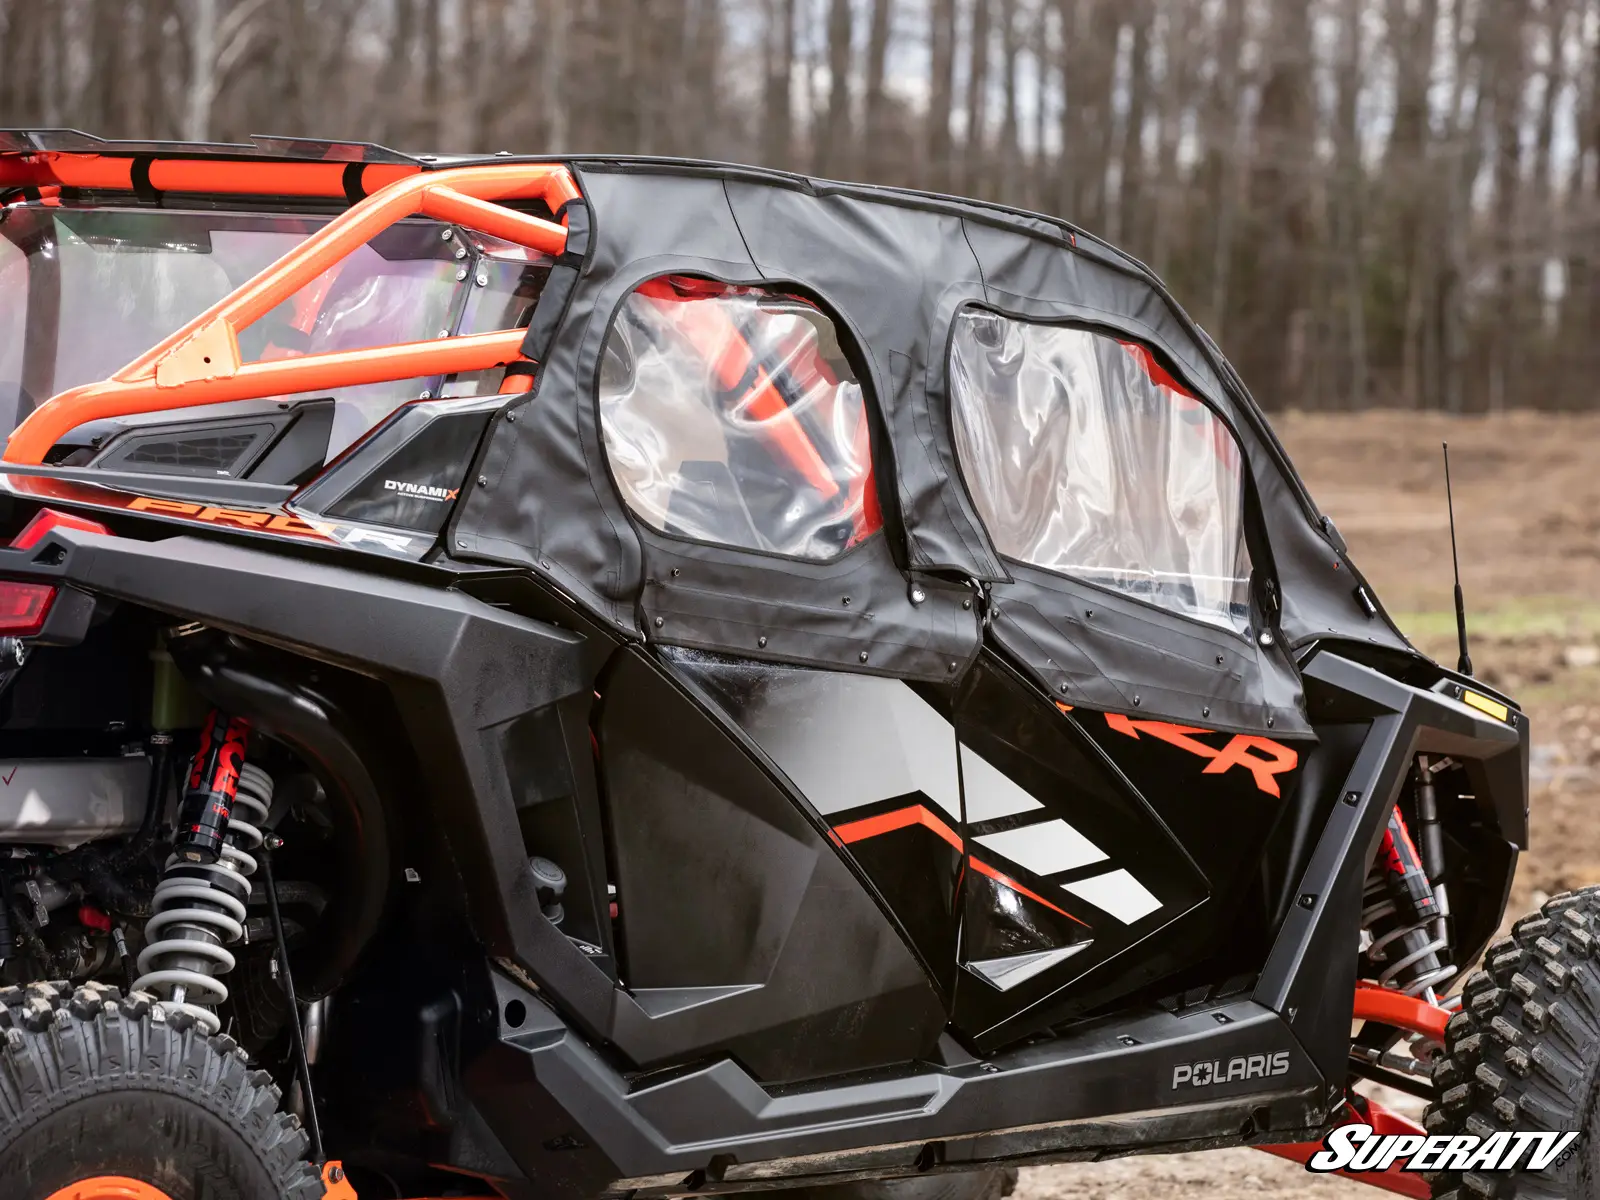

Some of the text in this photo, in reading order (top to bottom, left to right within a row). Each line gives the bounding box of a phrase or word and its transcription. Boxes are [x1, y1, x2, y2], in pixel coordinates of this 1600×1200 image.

[384, 479, 460, 501] DYNAMIX
[127, 496, 413, 553] PRO R
[1172, 1051, 1290, 1090] POLARIS
